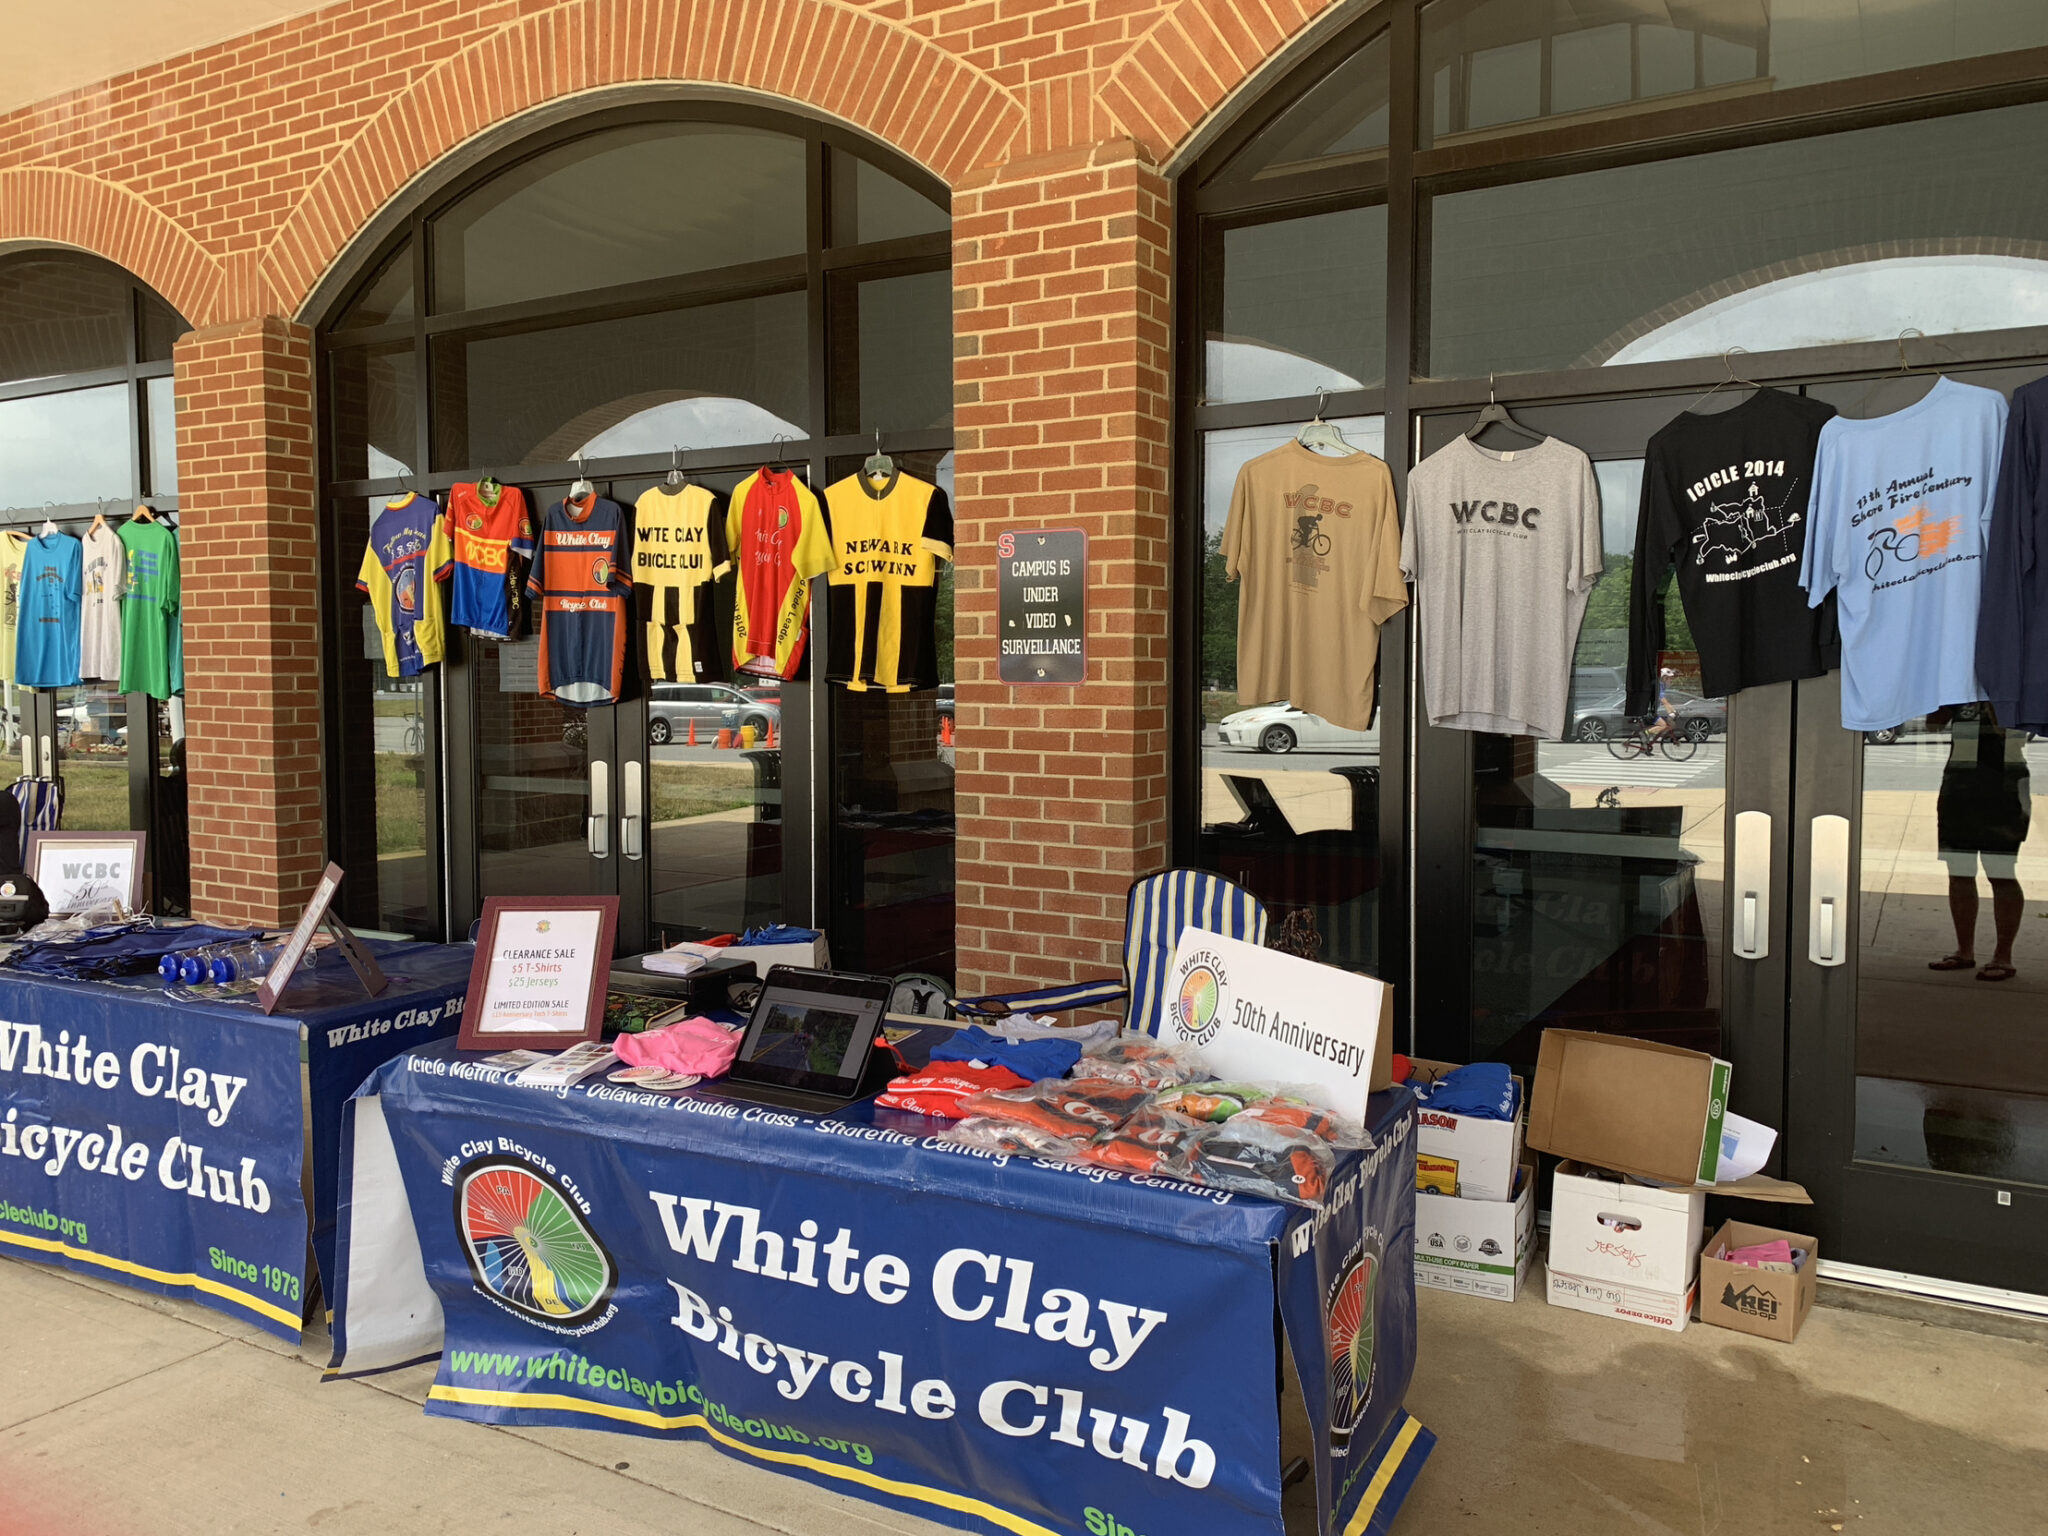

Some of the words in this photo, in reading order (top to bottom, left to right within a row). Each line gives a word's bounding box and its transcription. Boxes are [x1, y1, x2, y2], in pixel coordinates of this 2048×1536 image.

[1686, 465, 1740, 502] ICICLE
[1744, 460, 1785, 478] 2014
[1886, 467, 1934, 494] Annual
[1283, 492, 1353, 518] WCBC
[1449, 500, 1542, 531] WCBC
[1851, 504, 1883, 528] Shore
[556, 533, 587, 545] White
[588, 532, 611, 549] Clay
[846, 539, 913, 555] NEWARK
[998, 533, 1015, 558] S
[1012, 560, 1057, 577] CAMPUS
[1060, 560, 1070, 575] IS
[792, 588, 804, 609] Ride
[1023, 586, 1058, 602] UNDER
[777, 612, 797, 645] Leader
[1025, 613, 1056, 628] VIDEO
[1002, 638, 1081, 655] SURVEILLANCE
[62, 863, 121, 879] WCBC
[503, 949, 551, 960] CLEARANCE
[553, 948, 576, 959] SALE
[512, 963, 523, 974] $5
[526, 963, 562, 973] T-Shirts
[1179, 951, 1212, 976] WHITE
[1211, 955, 1228, 988] CLAY
[508, 977, 525, 987] $25
[526, 977, 559, 988] Jerseys
[493, 1000, 521, 1009] LIMITED
[522, 1000, 550, 1009] EDITION
[551, 1000, 570, 1008] SALE
[327, 1023, 391, 1048] White
[394, 1008, 442, 1027] Clay
[1197, 1017, 1221, 1046] CLUB
[1232, 998, 1267, 1035] 50th
[1268, 1011, 1365, 1077] Anniversary
[130, 1042, 247, 1127] Clay
[1175, 1104, 1189, 1115] PA
[407, 1054, 446, 1077] Icicle
[449, 1061, 501, 1084] Metric
[586, 1083, 671, 1110] Delaware
[674, 1096, 737, 1119] Double
[741, 1106, 798, 1128] Cross
[814, 1118, 915, 1146] Shorefire
[1032, 1156, 1120, 1183] Savage
[1129, 1173, 1234, 1205] Century
[0, 1107, 149, 1181] icycle
[158, 1136, 272, 1214] Club
[441, 1155, 461, 1187] White
[460, 1140, 494, 1158] Clay
[498, 1137, 557, 1175] Bicycle
[560, 1174, 592, 1216] Club
[1332, 1174, 1358, 1215] Clay
[1341, 1238, 1362, 1270] Clay
[1430, 1240, 1444, 1248] USA
[208, 1246, 258, 1284] Since
[261, 1263, 300, 1301] 1973
[1443, 1258, 1459, 1268] COPY
[1460, 1261, 1480, 1270] PAPER
[649, 1191, 910, 1304] White
[931, 1247, 1167, 1371] Clay
[472, 1285, 619, 1338] www.whiteclaybicycleclub.org
[1615, 1307, 1644, 1319] DEPOT
[1740, 1295, 1777, 1314] REI
[1644, 1313, 1673, 1326] Office
[667, 1278, 956, 1421] Bicycle
[978, 1380, 1217, 1489] Club
[450, 1347, 874, 1466] www.whiteclaybicycleclub.org
